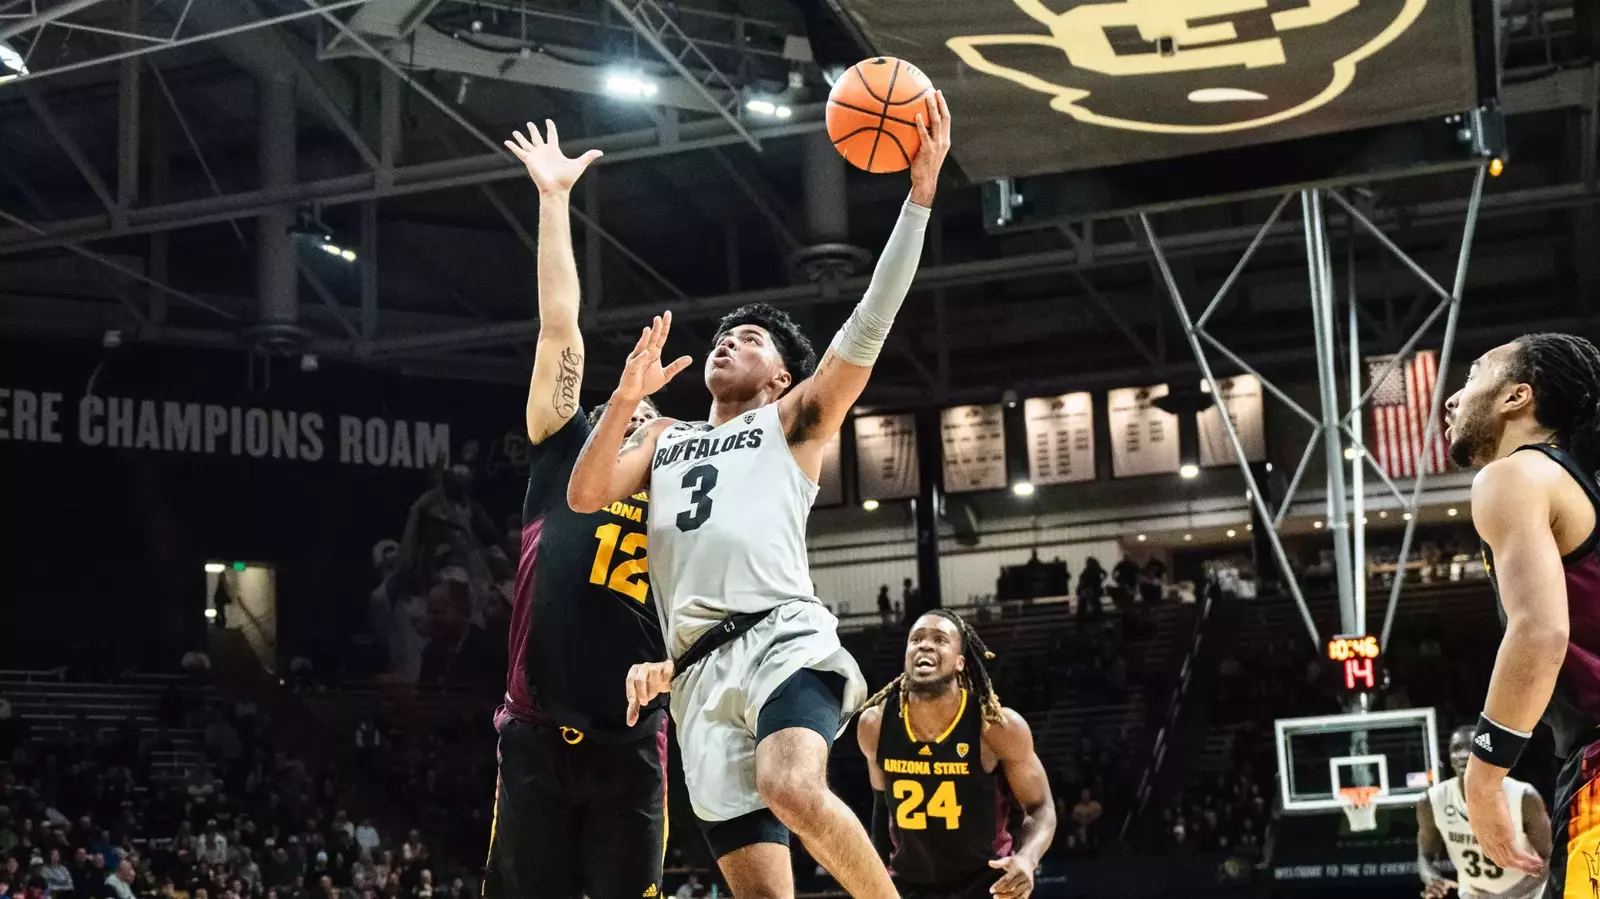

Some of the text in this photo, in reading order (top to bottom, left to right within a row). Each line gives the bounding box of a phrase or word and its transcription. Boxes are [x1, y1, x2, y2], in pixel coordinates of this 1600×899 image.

[78, 394, 324, 461] CHAMPIONS
[339, 414, 450, 470] ROAM
[653, 428, 764, 471] BUFFALOES
[676, 464, 719, 533] 3
[589, 523, 649, 604] 12
[1328, 636, 1380, 661] 10:46
[1345, 658, 1375, 690] 14
[884, 759, 970, 775] ARIZONA STATE
[893, 779, 963, 830] 24
[1326, 865, 1340, 878] TO
[1462, 849, 1504, 879] 35
